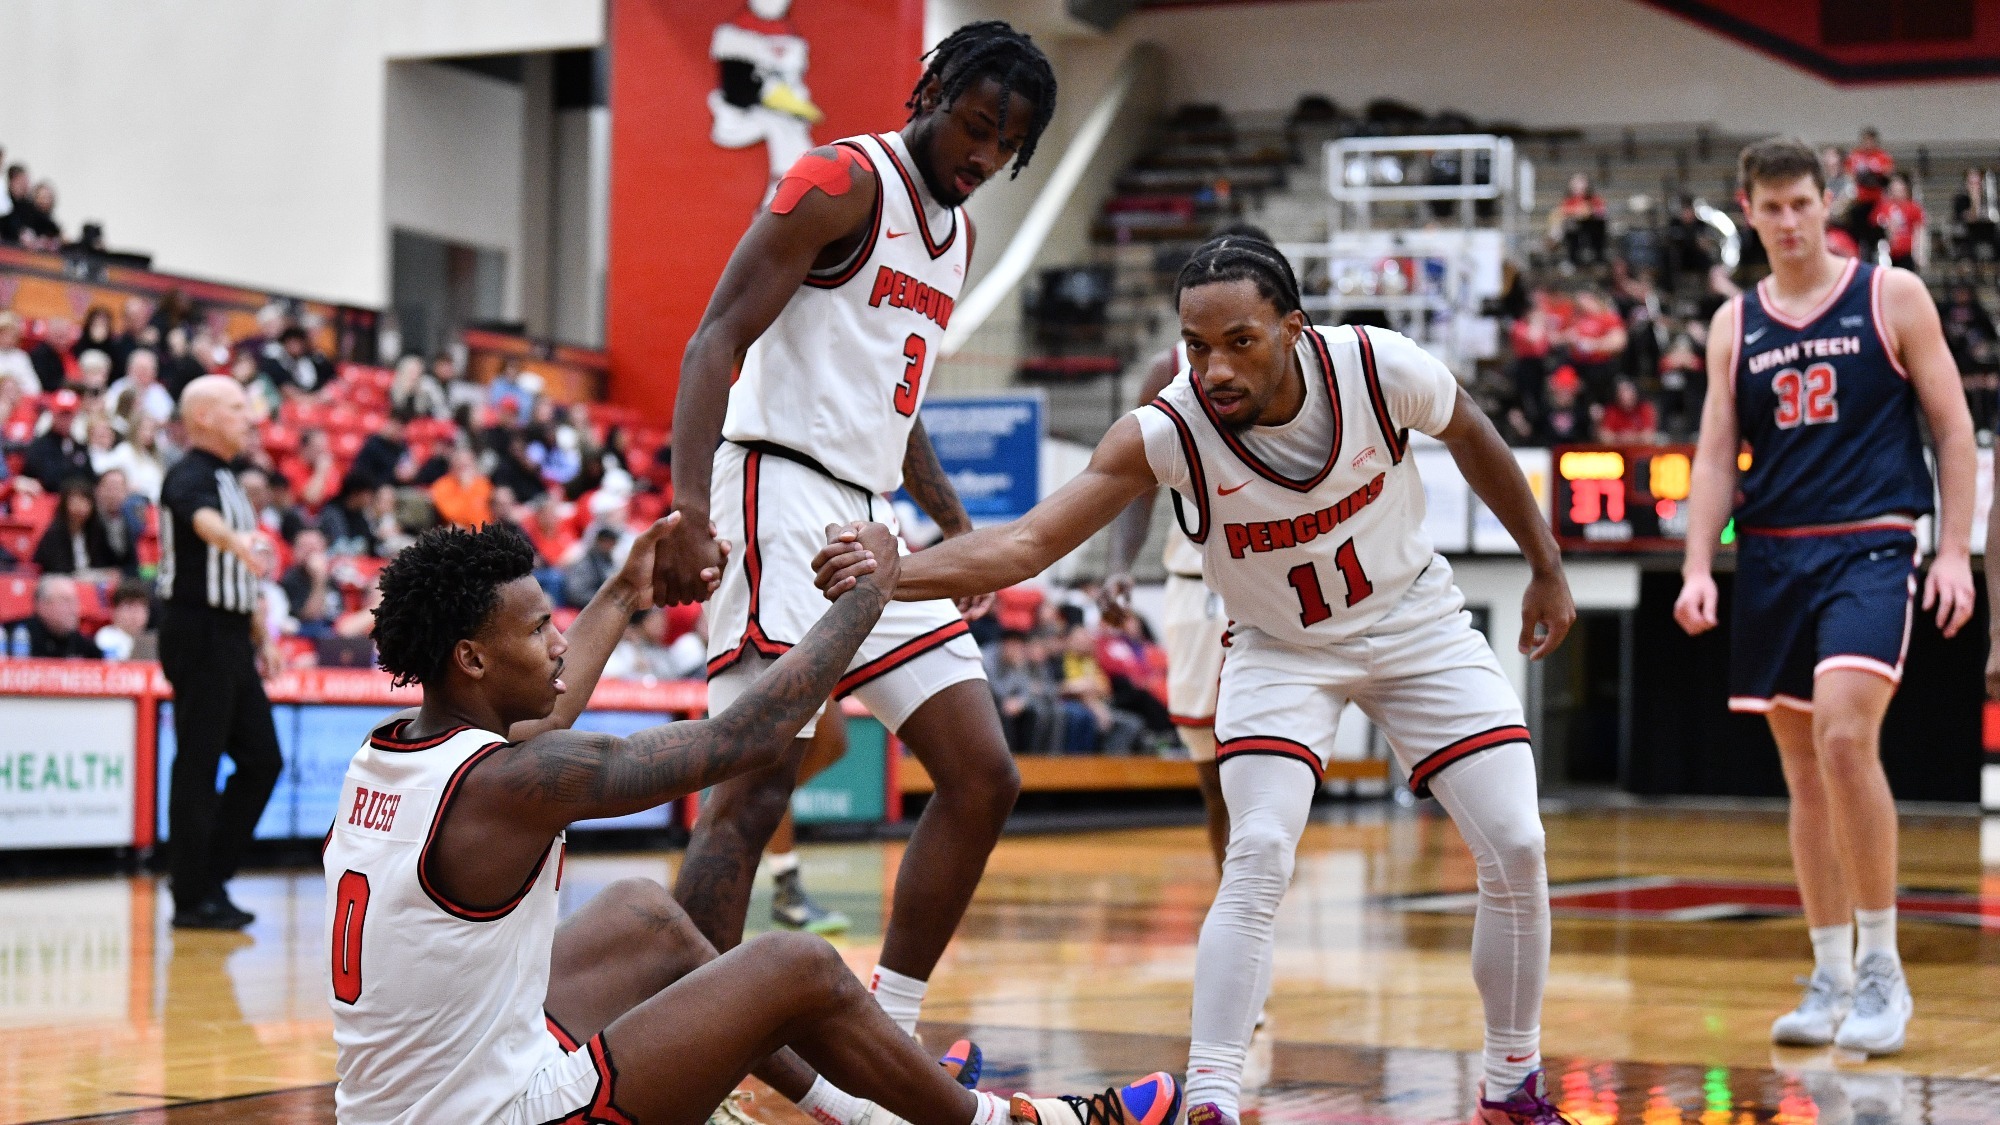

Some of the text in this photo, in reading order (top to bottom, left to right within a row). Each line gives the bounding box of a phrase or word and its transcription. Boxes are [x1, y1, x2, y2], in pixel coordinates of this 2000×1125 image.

[868, 265, 955, 331] PENGUIN
[893, 332, 927, 418] 3
[1748, 336, 1861, 374] UTAH TECH
[1771, 362, 1839, 431] 32
[1224, 472, 1386, 559] PENGUINS
[1287, 536, 1373, 629] 11
[0, 752, 124, 791] HEALTH
[348, 786, 402, 832] RUSH
[332, 868, 371, 1006] 0
